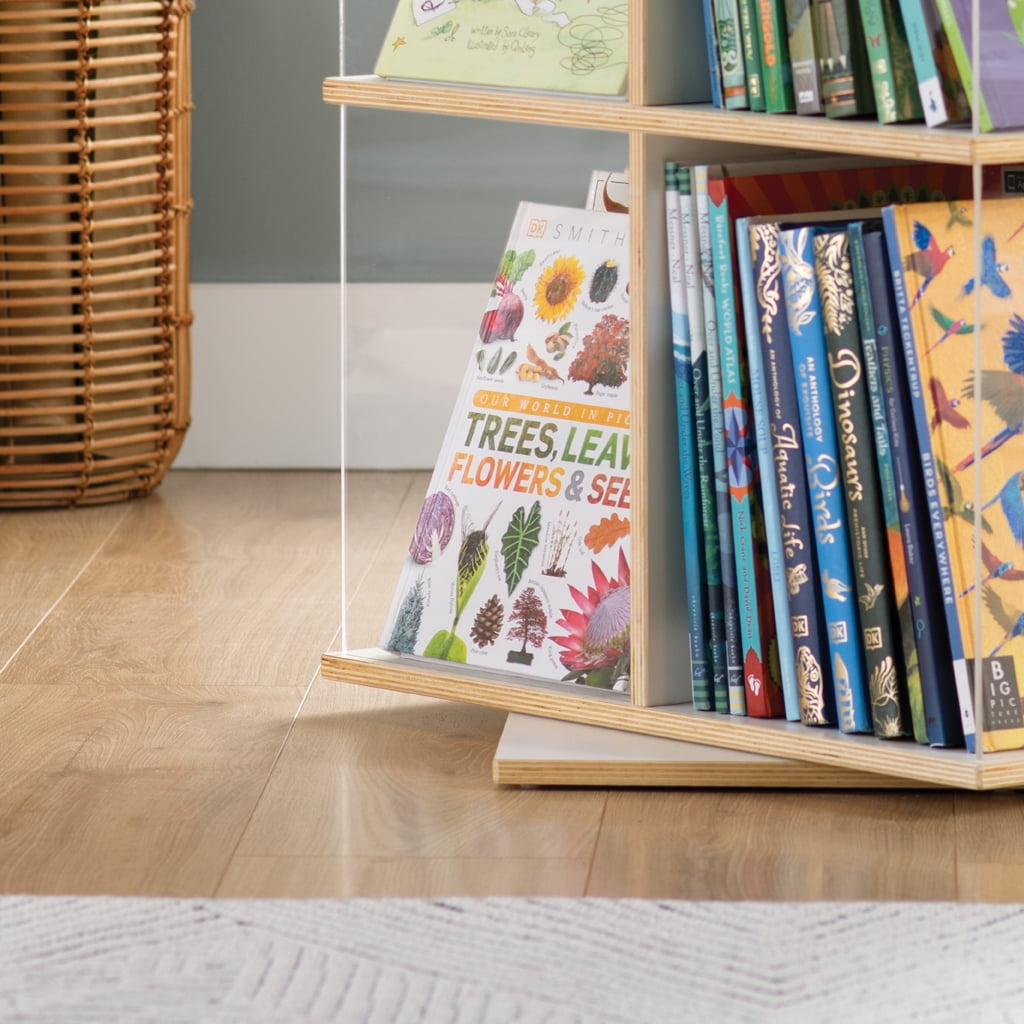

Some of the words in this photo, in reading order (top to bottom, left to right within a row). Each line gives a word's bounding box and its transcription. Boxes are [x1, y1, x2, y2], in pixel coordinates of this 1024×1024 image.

[715, 215, 726, 259] Barefoot
[685, 264, 695, 289] Neal
[719, 263, 729, 294] Books
[721, 298, 733, 344] WORLD
[725, 346, 736, 384] ATLAS
[768, 349, 777, 360] AN
[807, 357, 815, 373] AN
[864, 338, 878, 393] Feathers
[692, 368, 703, 395] Over
[770, 361, 780, 409] ANTHOLOGY
[479, 393, 510, 408] OUR
[520, 399, 572, 417] WORLD
[580, 407, 599, 420] IN
[694, 397, 704, 417] and
[774, 410, 783, 420] OF
[809, 376, 823, 442] ANTHOLOGY
[871, 395, 886, 420] and
[464, 411, 559, 462] TREES,
[695, 420, 707, 451] Under
[829, 348, 864, 501] Dinosaurs
[876, 424, 888, 456] Tails
[893, 270, 906, 314] BRITTA
[900, 316, 920, 399] TECKENTRUP
[920, 452, 936, 496] BIRDS
[930, 501, 952, 605] EVERYWHERE
[447, 452, 566, 498] FLOWERS
[564, 470, 585, 502] &
[698, 455, 708, 471] the
[771, 422, 798, 509] Aquatic
[808, 453, 842, 545] Birds
[781, 513, 804, 558] Life
[990, 660, 1004, 680] B
[990, 697, 1017, 709] PIC
